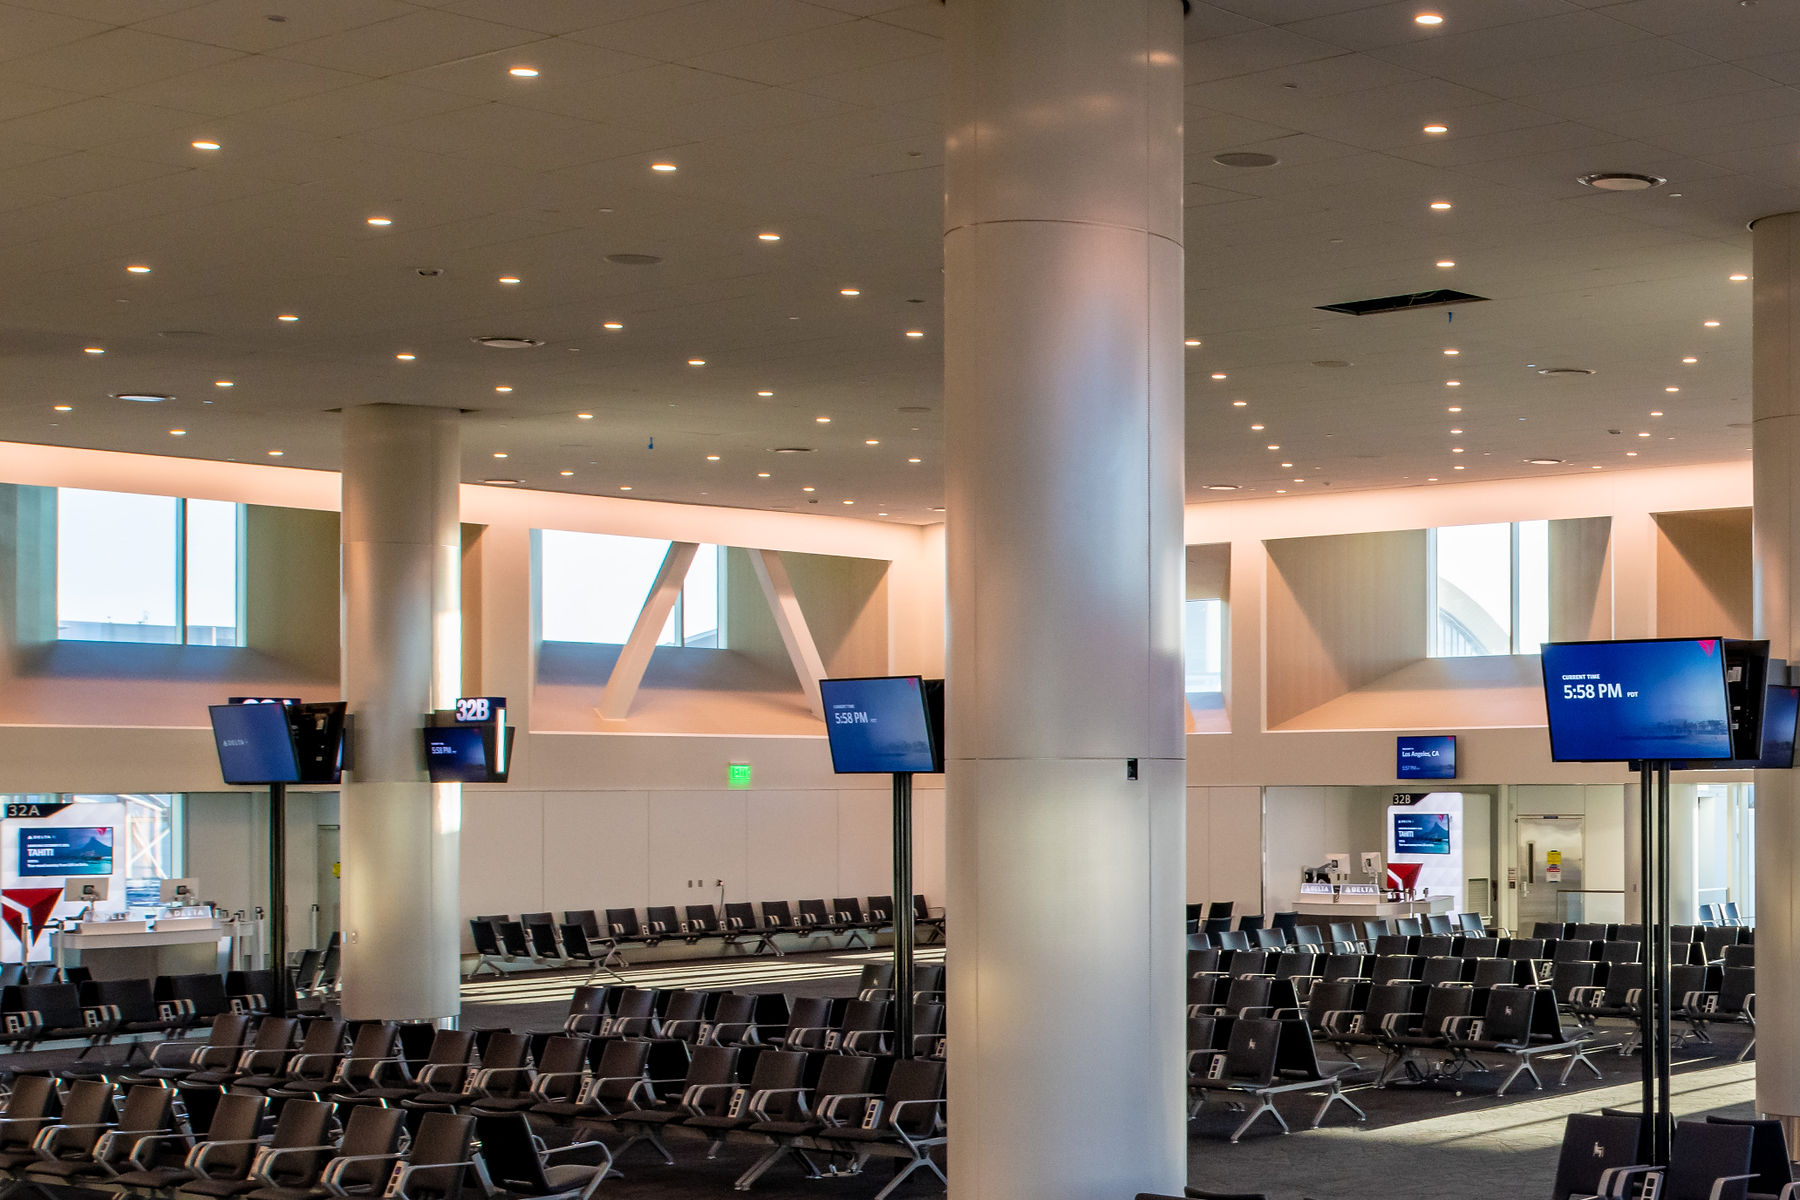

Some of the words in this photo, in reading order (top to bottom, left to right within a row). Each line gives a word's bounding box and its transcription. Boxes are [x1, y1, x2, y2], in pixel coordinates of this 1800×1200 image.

[1563, 684, 1596, 699] 5:58
[1598, 683, 1623, 698] PM
[456, 698, 489, 721] 32B
[835, 713, 853, 724] 5:58
[854, 712, 869, 723] PM
[1393, 794, 1411, 804] 32B
[8, 805, 40, 817] 32A
